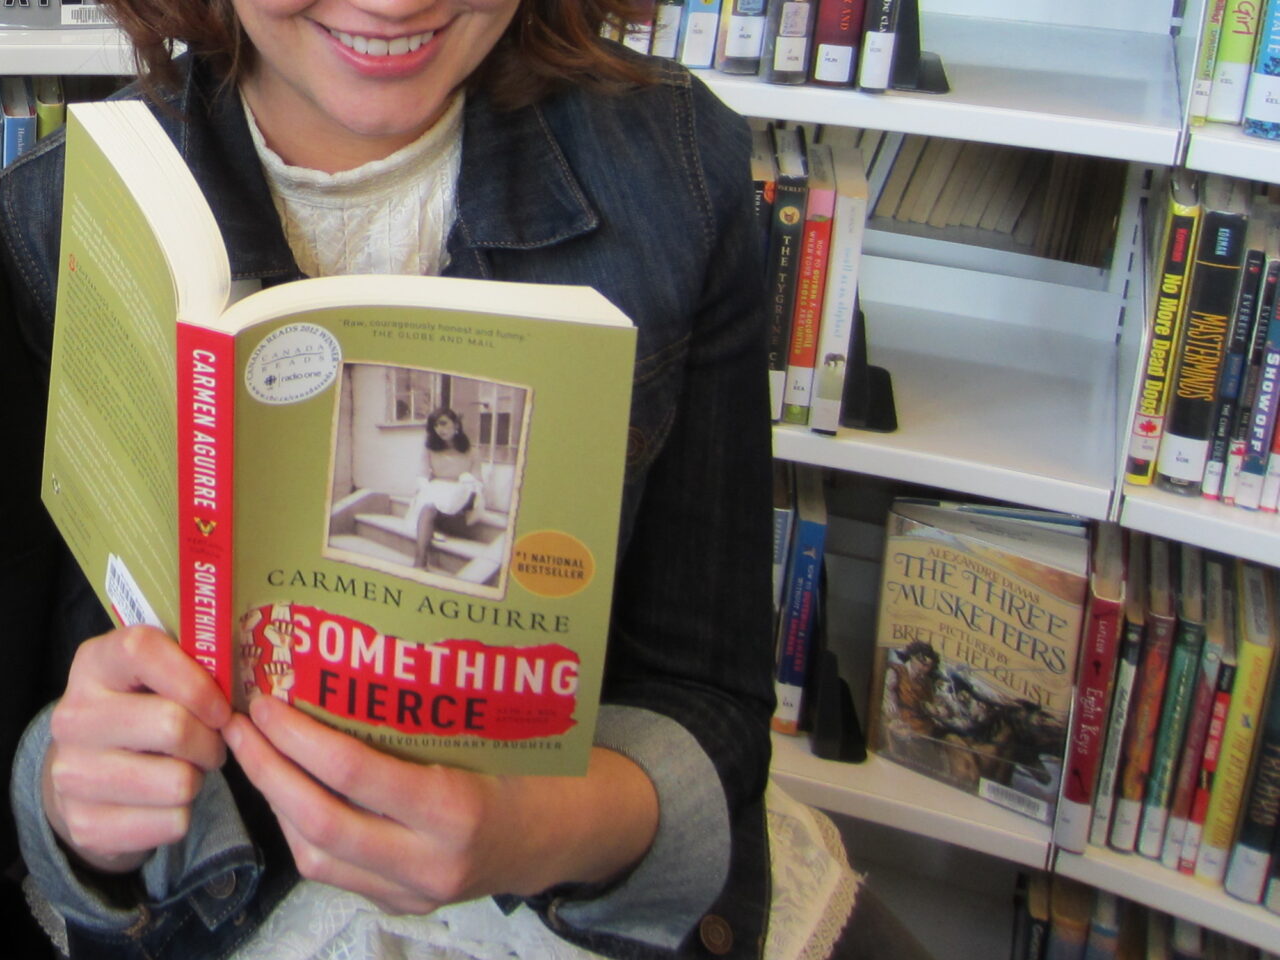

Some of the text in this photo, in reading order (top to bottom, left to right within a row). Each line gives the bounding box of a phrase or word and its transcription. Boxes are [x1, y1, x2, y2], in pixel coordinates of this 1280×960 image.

[839, 7, 853, 31] AND
[1232, 0, 1257, 37] Girl
[1170, 227, 1188, 263] Korman
[266, 325, 339, 362] READS 2012 WINNER
[372, 329, 495, 348] THE GLOBE AND MAIL
[770, 273, 786, 346] TYGRINE
[1235, 293, 1252, 341] EVEREST
[1254, 305, 1271, 350] EVEREST
[1138, 272, 1183, 416] No More Dead Dogs
[1176, 310, 1228, 402] MASTERMINDS
[191, 348, 216, 427] CARMEN
[192, 430, 216, 510] AGUIRRE
[516, 561, 586, 582] BESTSELLER
[531, 550, 585, 569] NATIONAL
[193, 560, 217, 654] SOMETHING
[267, 567, 571, 635] CARMEN AGUIRRE
[886, 581, 1067, 675] MUSKETEERS
[894, 552, 1068, 642] THE THREE
[294, 613, 580, 696] SOMETHING
[892, 622, 1058, 707] BRETT HELQUIST
[318, 669, 488, 731] FIERCE
[1075, 686, 1104, 755] Eight Keys
[492, 738, 563, 751] DAUGHTER
